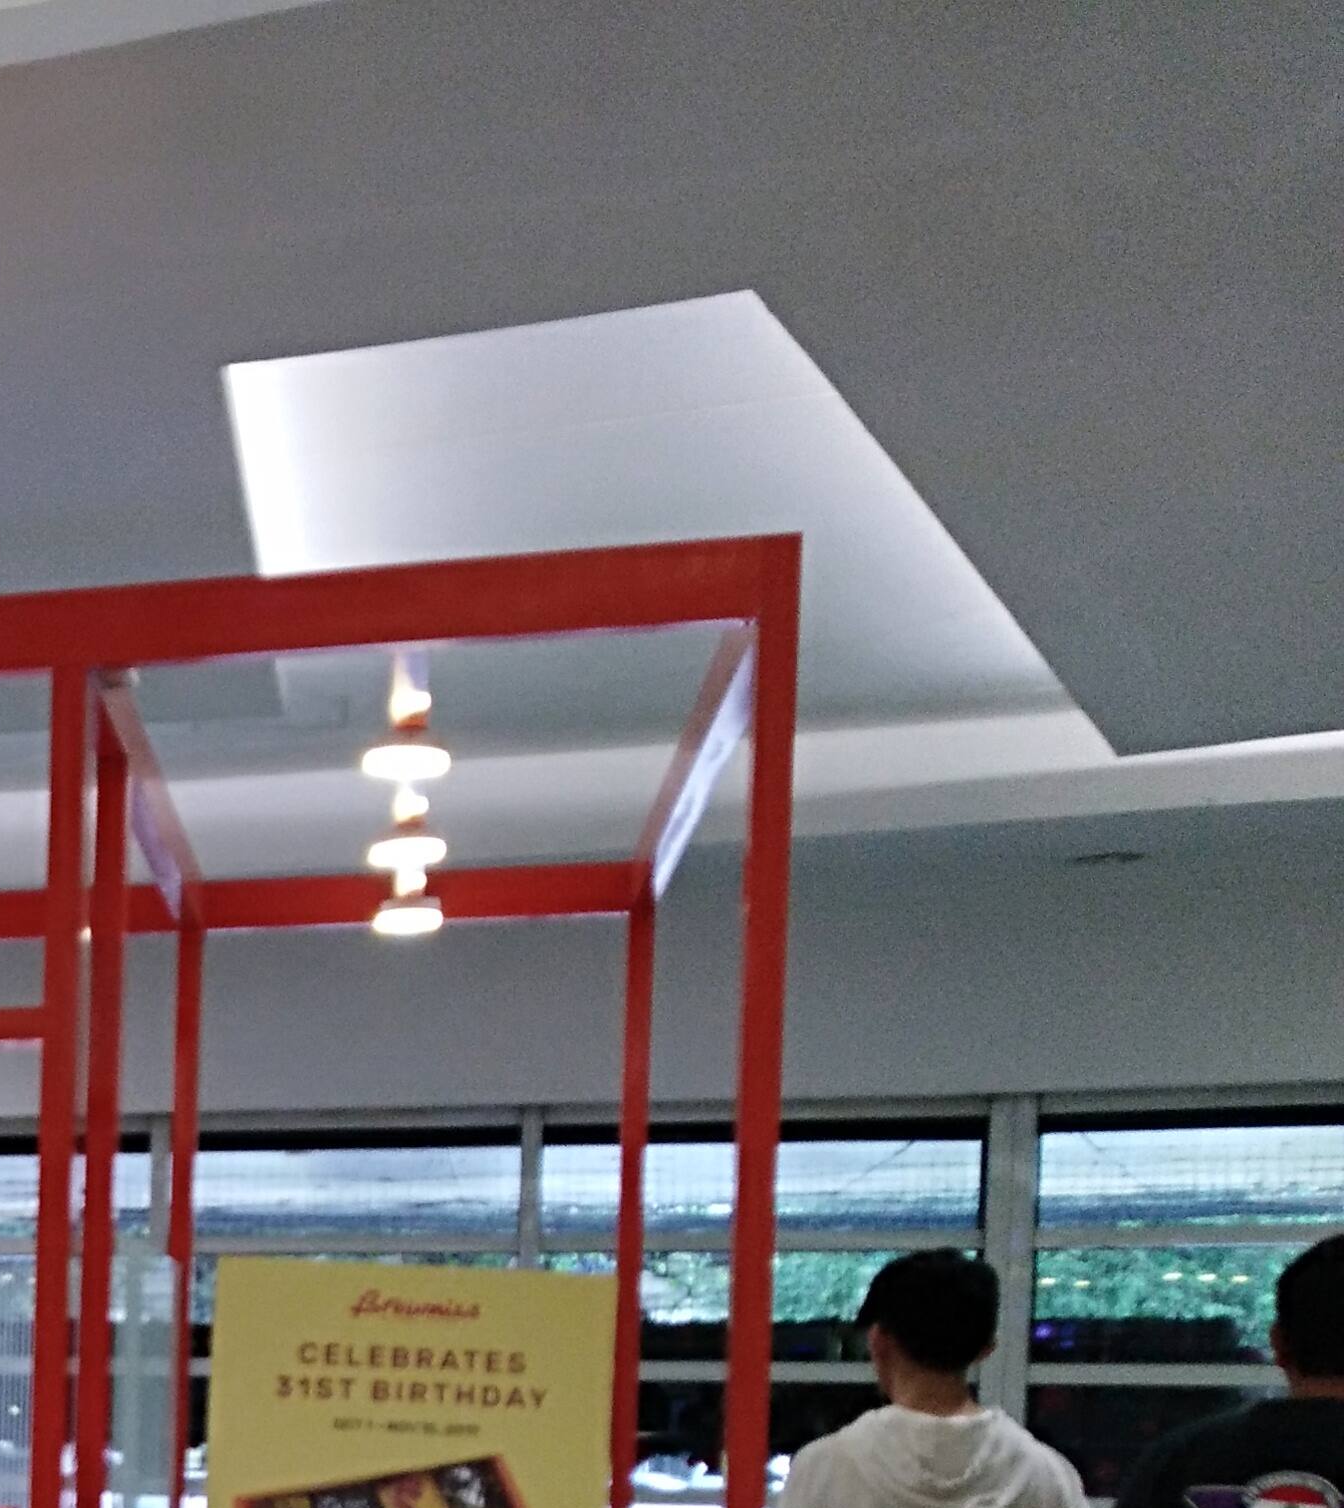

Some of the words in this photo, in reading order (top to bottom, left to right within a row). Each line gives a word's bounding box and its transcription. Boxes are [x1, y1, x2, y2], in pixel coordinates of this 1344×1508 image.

[350, 1289, 481, 1320] Brownies
[297, 1341, 527, 1374] CELEBRATES
[276, 1373, 355, 1400] 31ST
[371, 1379, 548, 1409] BIRTHDAY
